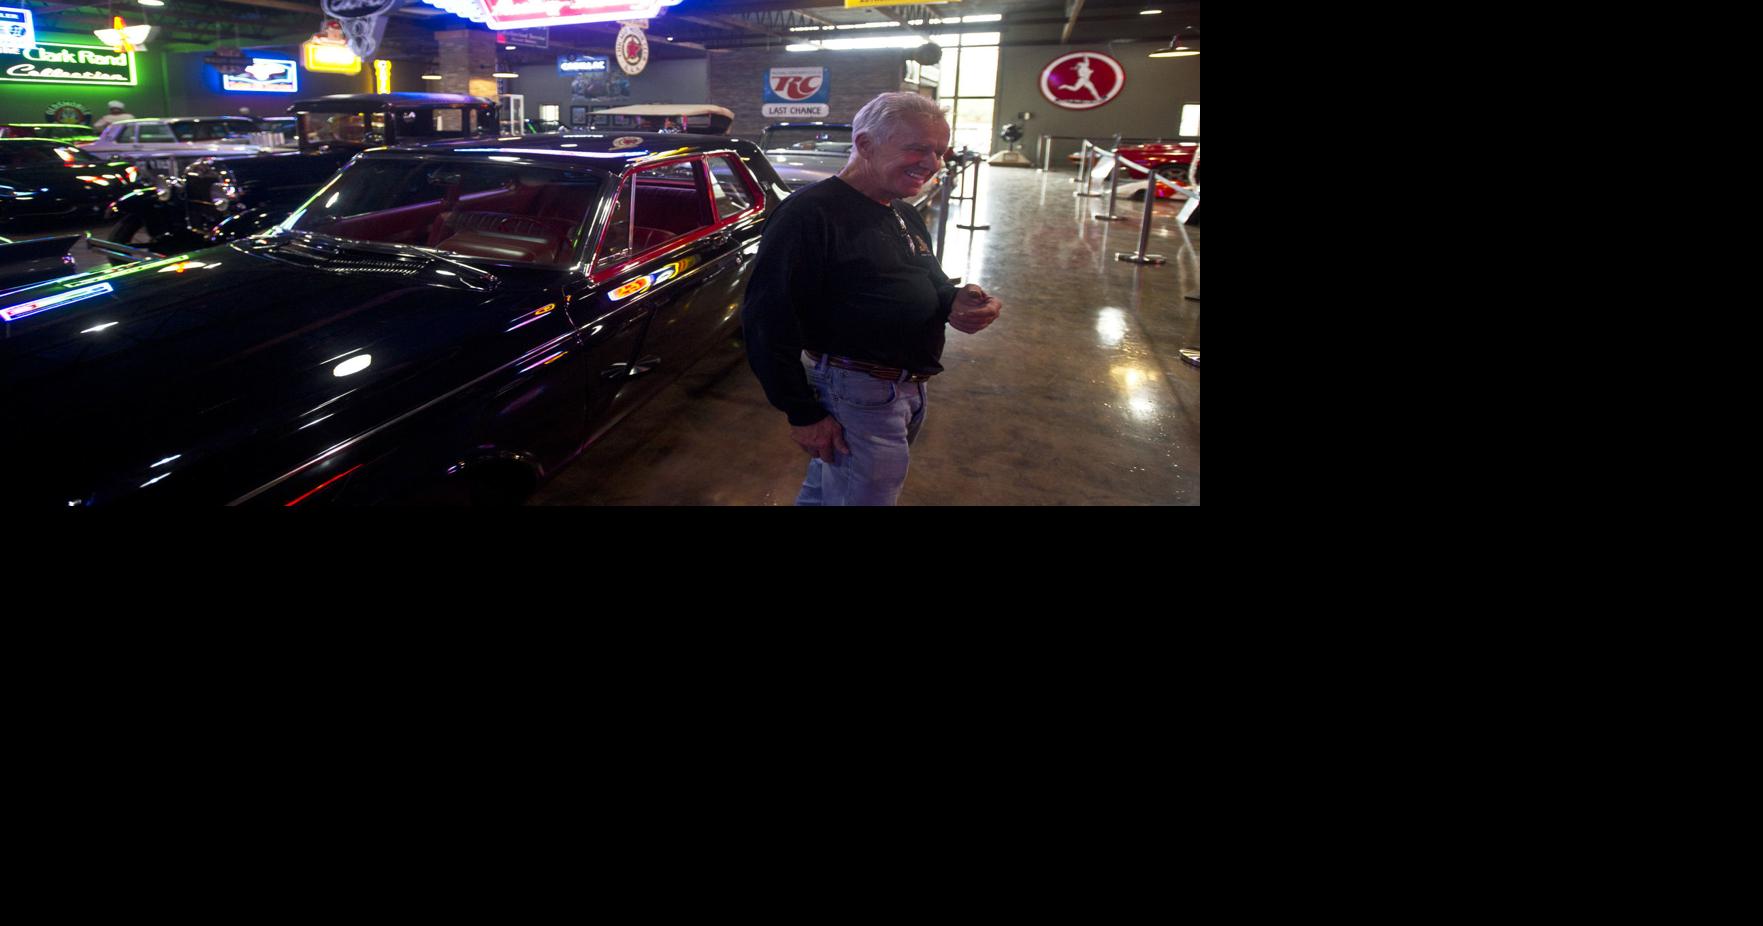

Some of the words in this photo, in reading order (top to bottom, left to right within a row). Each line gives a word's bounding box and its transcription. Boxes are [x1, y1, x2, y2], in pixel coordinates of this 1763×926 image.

[22, 47, 77, 64] Clark
[77, 50, 128, 67] Rand
[6, 63, 129, 81] Collection
[771, 75, 821, 99] RC
[769, 106, 787, 115] LAST
[789, 106, 822, 115] CHANCE
